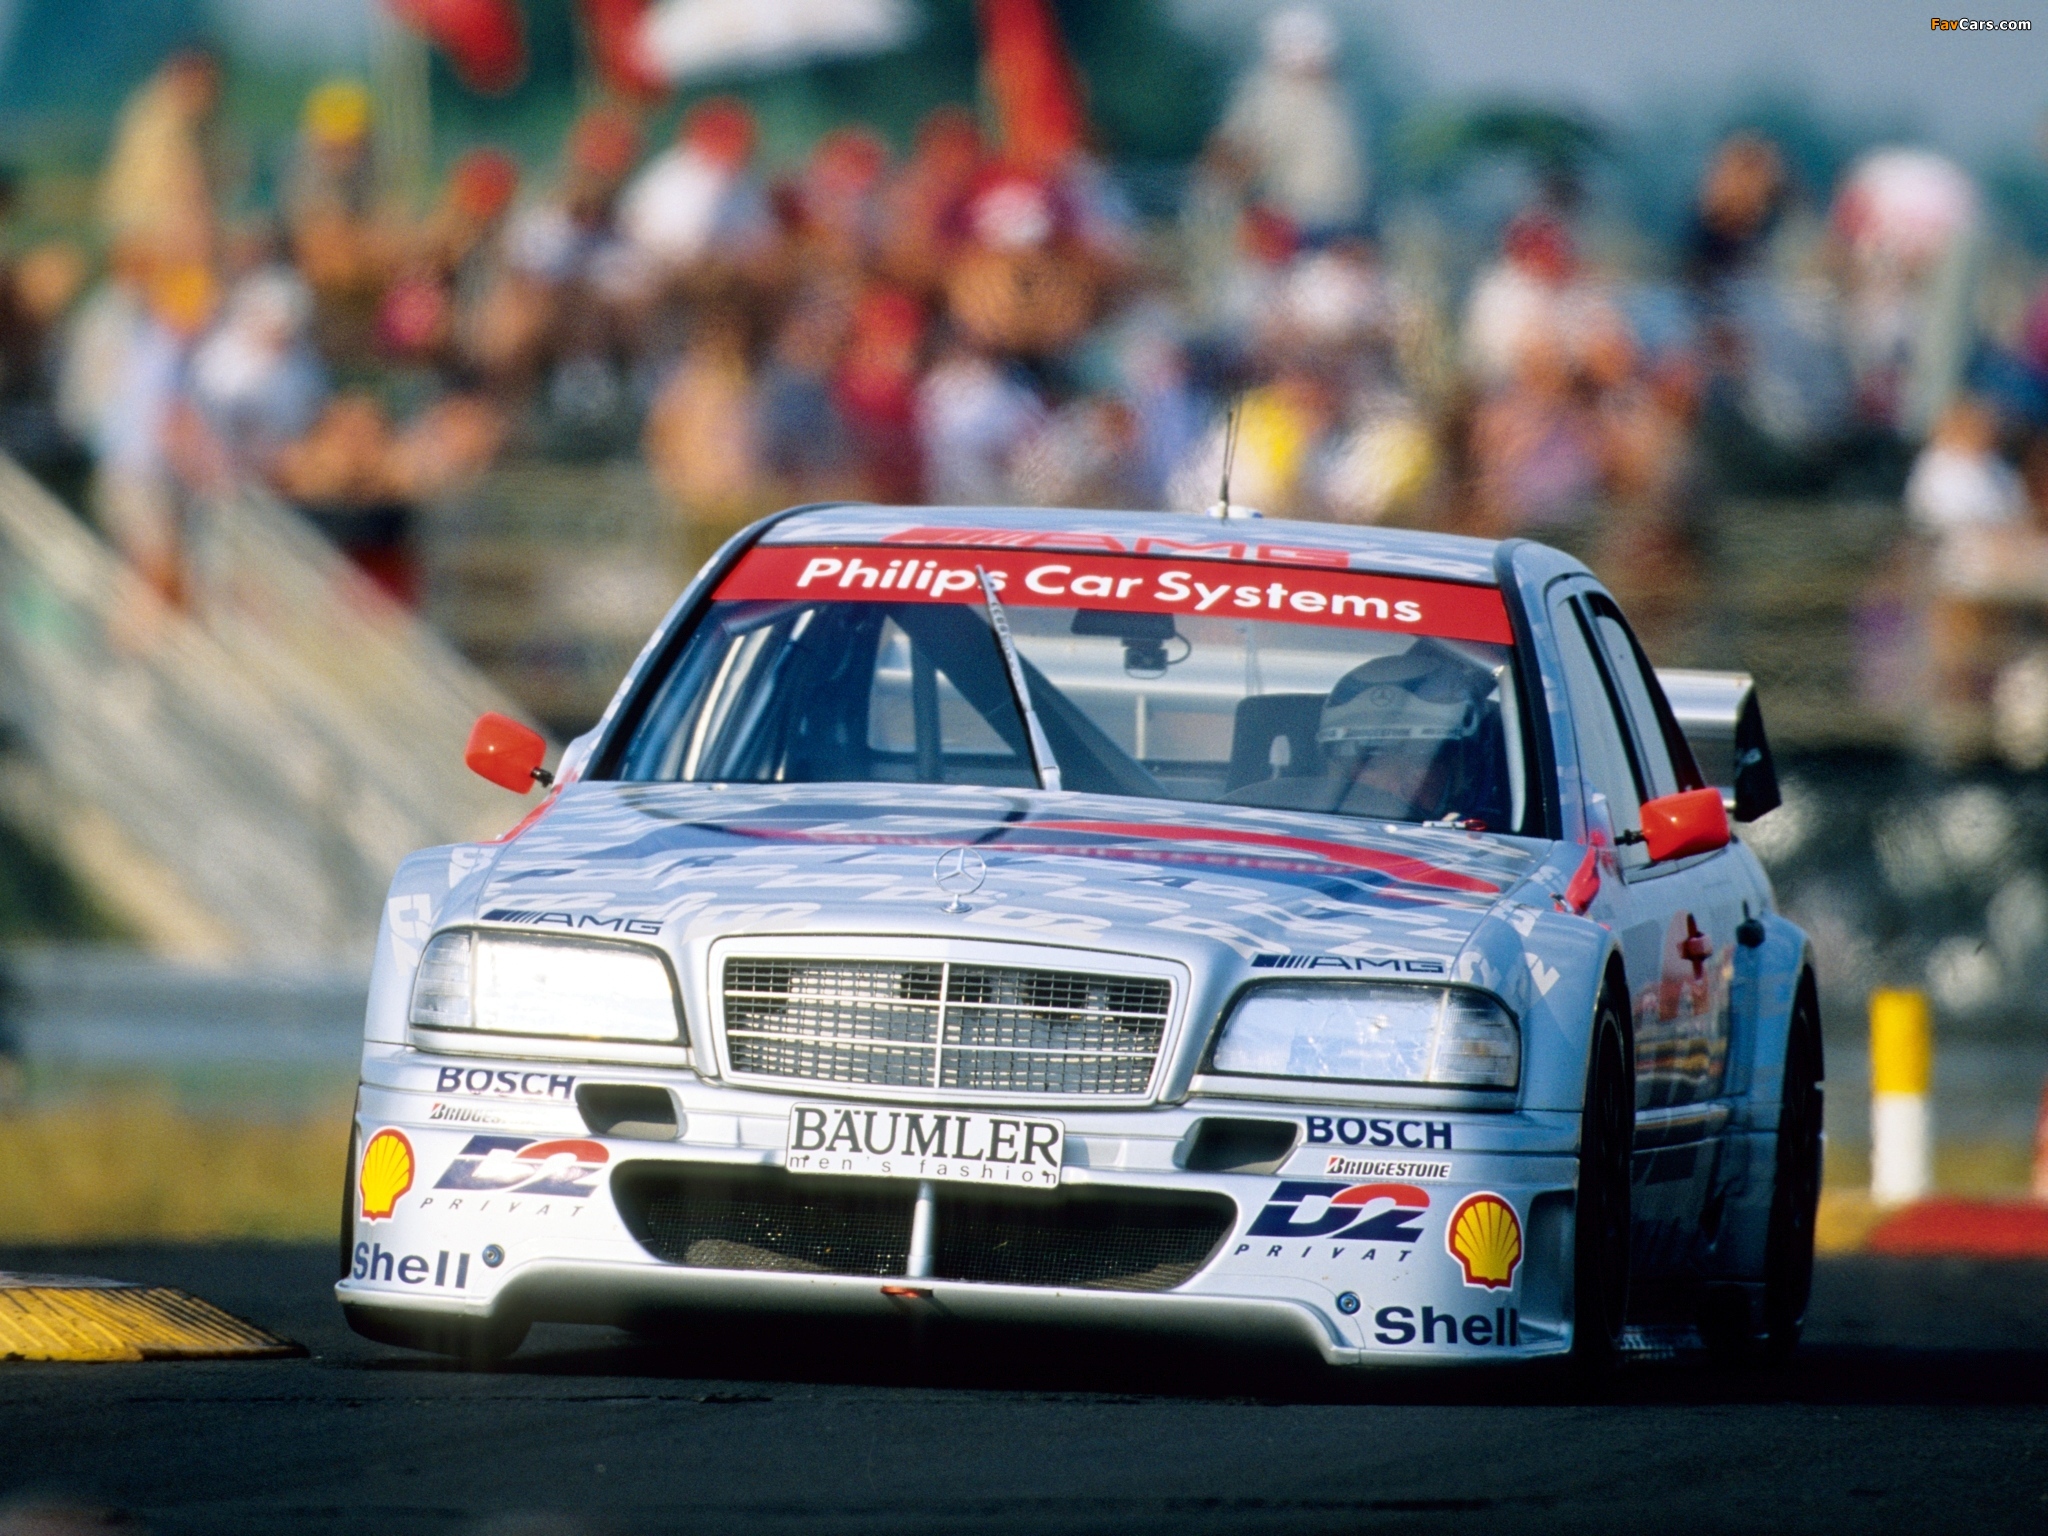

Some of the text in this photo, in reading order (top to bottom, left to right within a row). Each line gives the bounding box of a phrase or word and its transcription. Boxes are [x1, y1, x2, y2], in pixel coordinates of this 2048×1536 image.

[796, 558, 1423, 623] Philips Car Systems
[436, 1066, 577, 1100] BOSCH
[1306, 1115, 1452, 1150] BOSCH
[432, 1134, 610, 1198] D2
[919, 1159, 1057, 1185] fashion
[1326, 1156, 1451, 1179] BRIDGESTONE
[419, 1197, 585, 1217] PRIVAT
[1245, 1180, 1431, 1243] D2
[352, 1241, 471, 1290] Shell
[1233, 1244, 1413, 1263] PRIVAT
[1373, 1306, 1519, 1348] Shell
